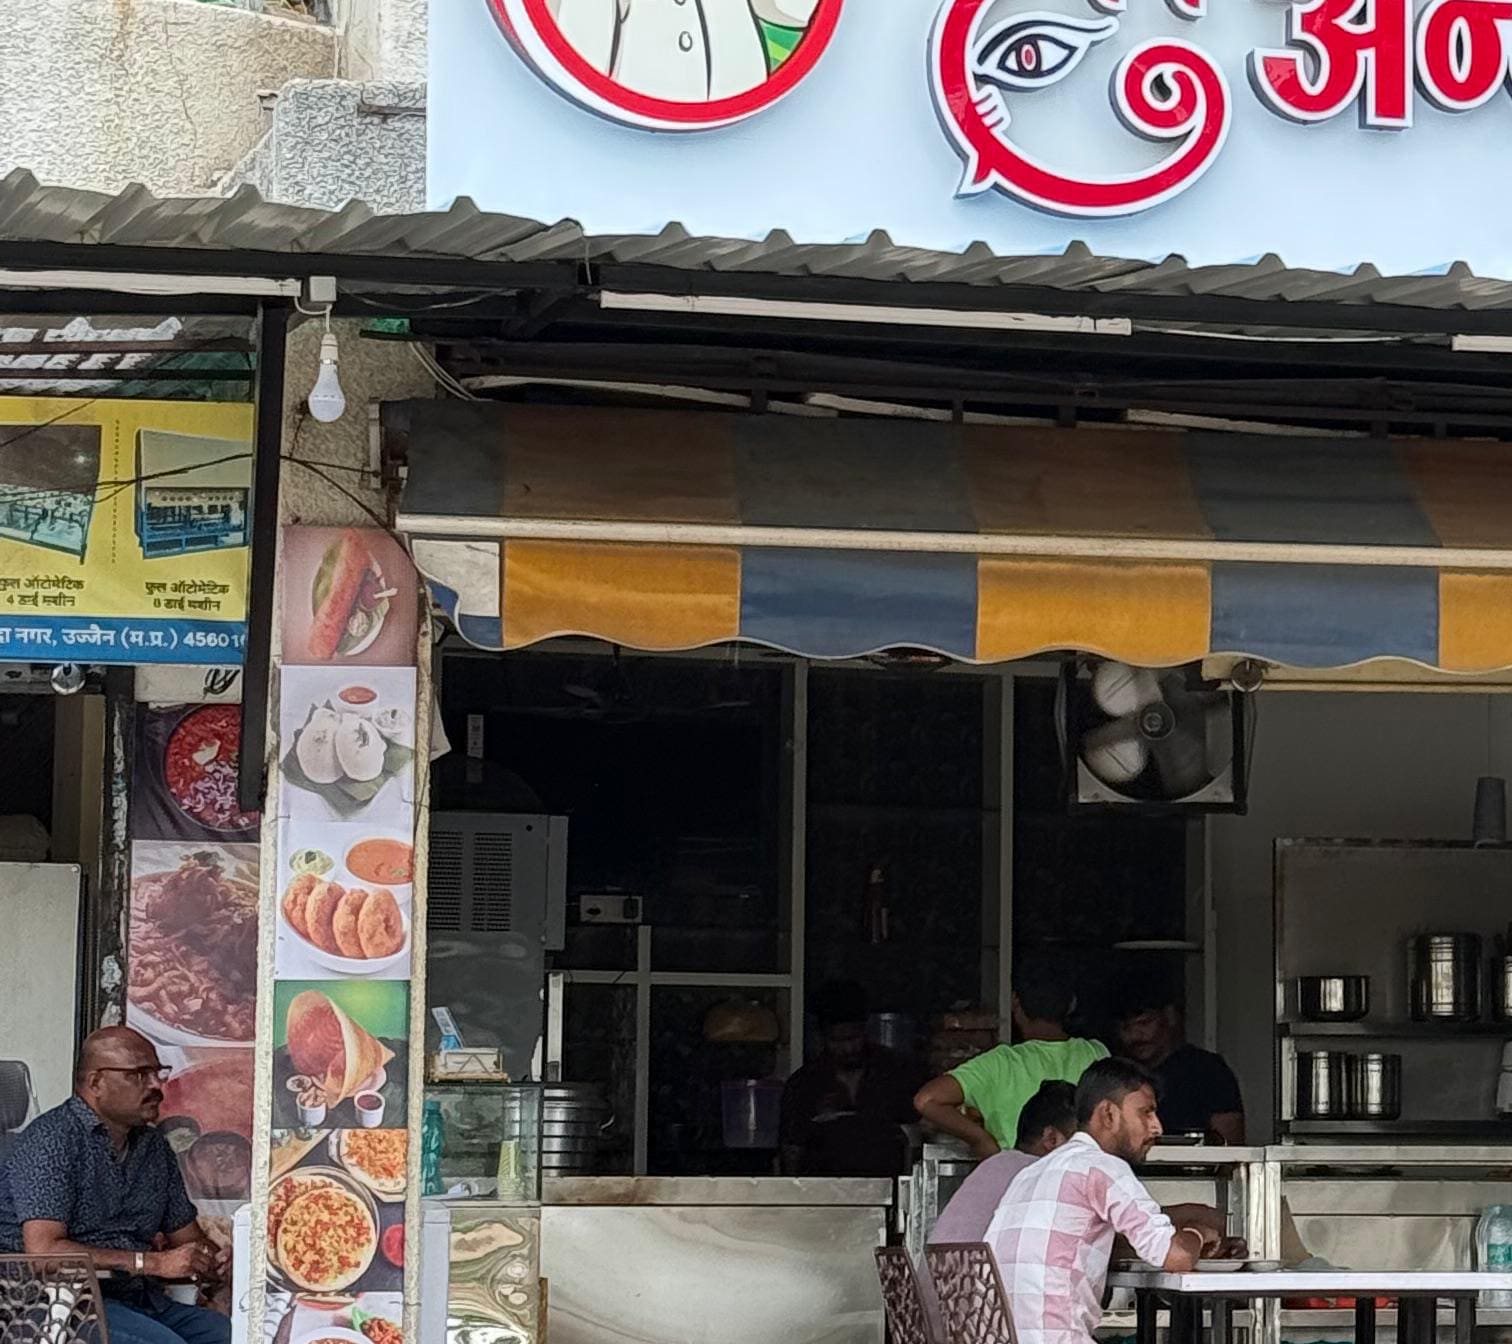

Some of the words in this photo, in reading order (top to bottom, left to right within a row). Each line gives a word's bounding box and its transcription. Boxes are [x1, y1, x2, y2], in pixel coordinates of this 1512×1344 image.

[145, 582, 167, 595] फुल
[14, 627, 58, 648] नगर,
[61, 624, 116, 646] उज्जैन
[120, 626, 178, 649] (म.प्र.)
